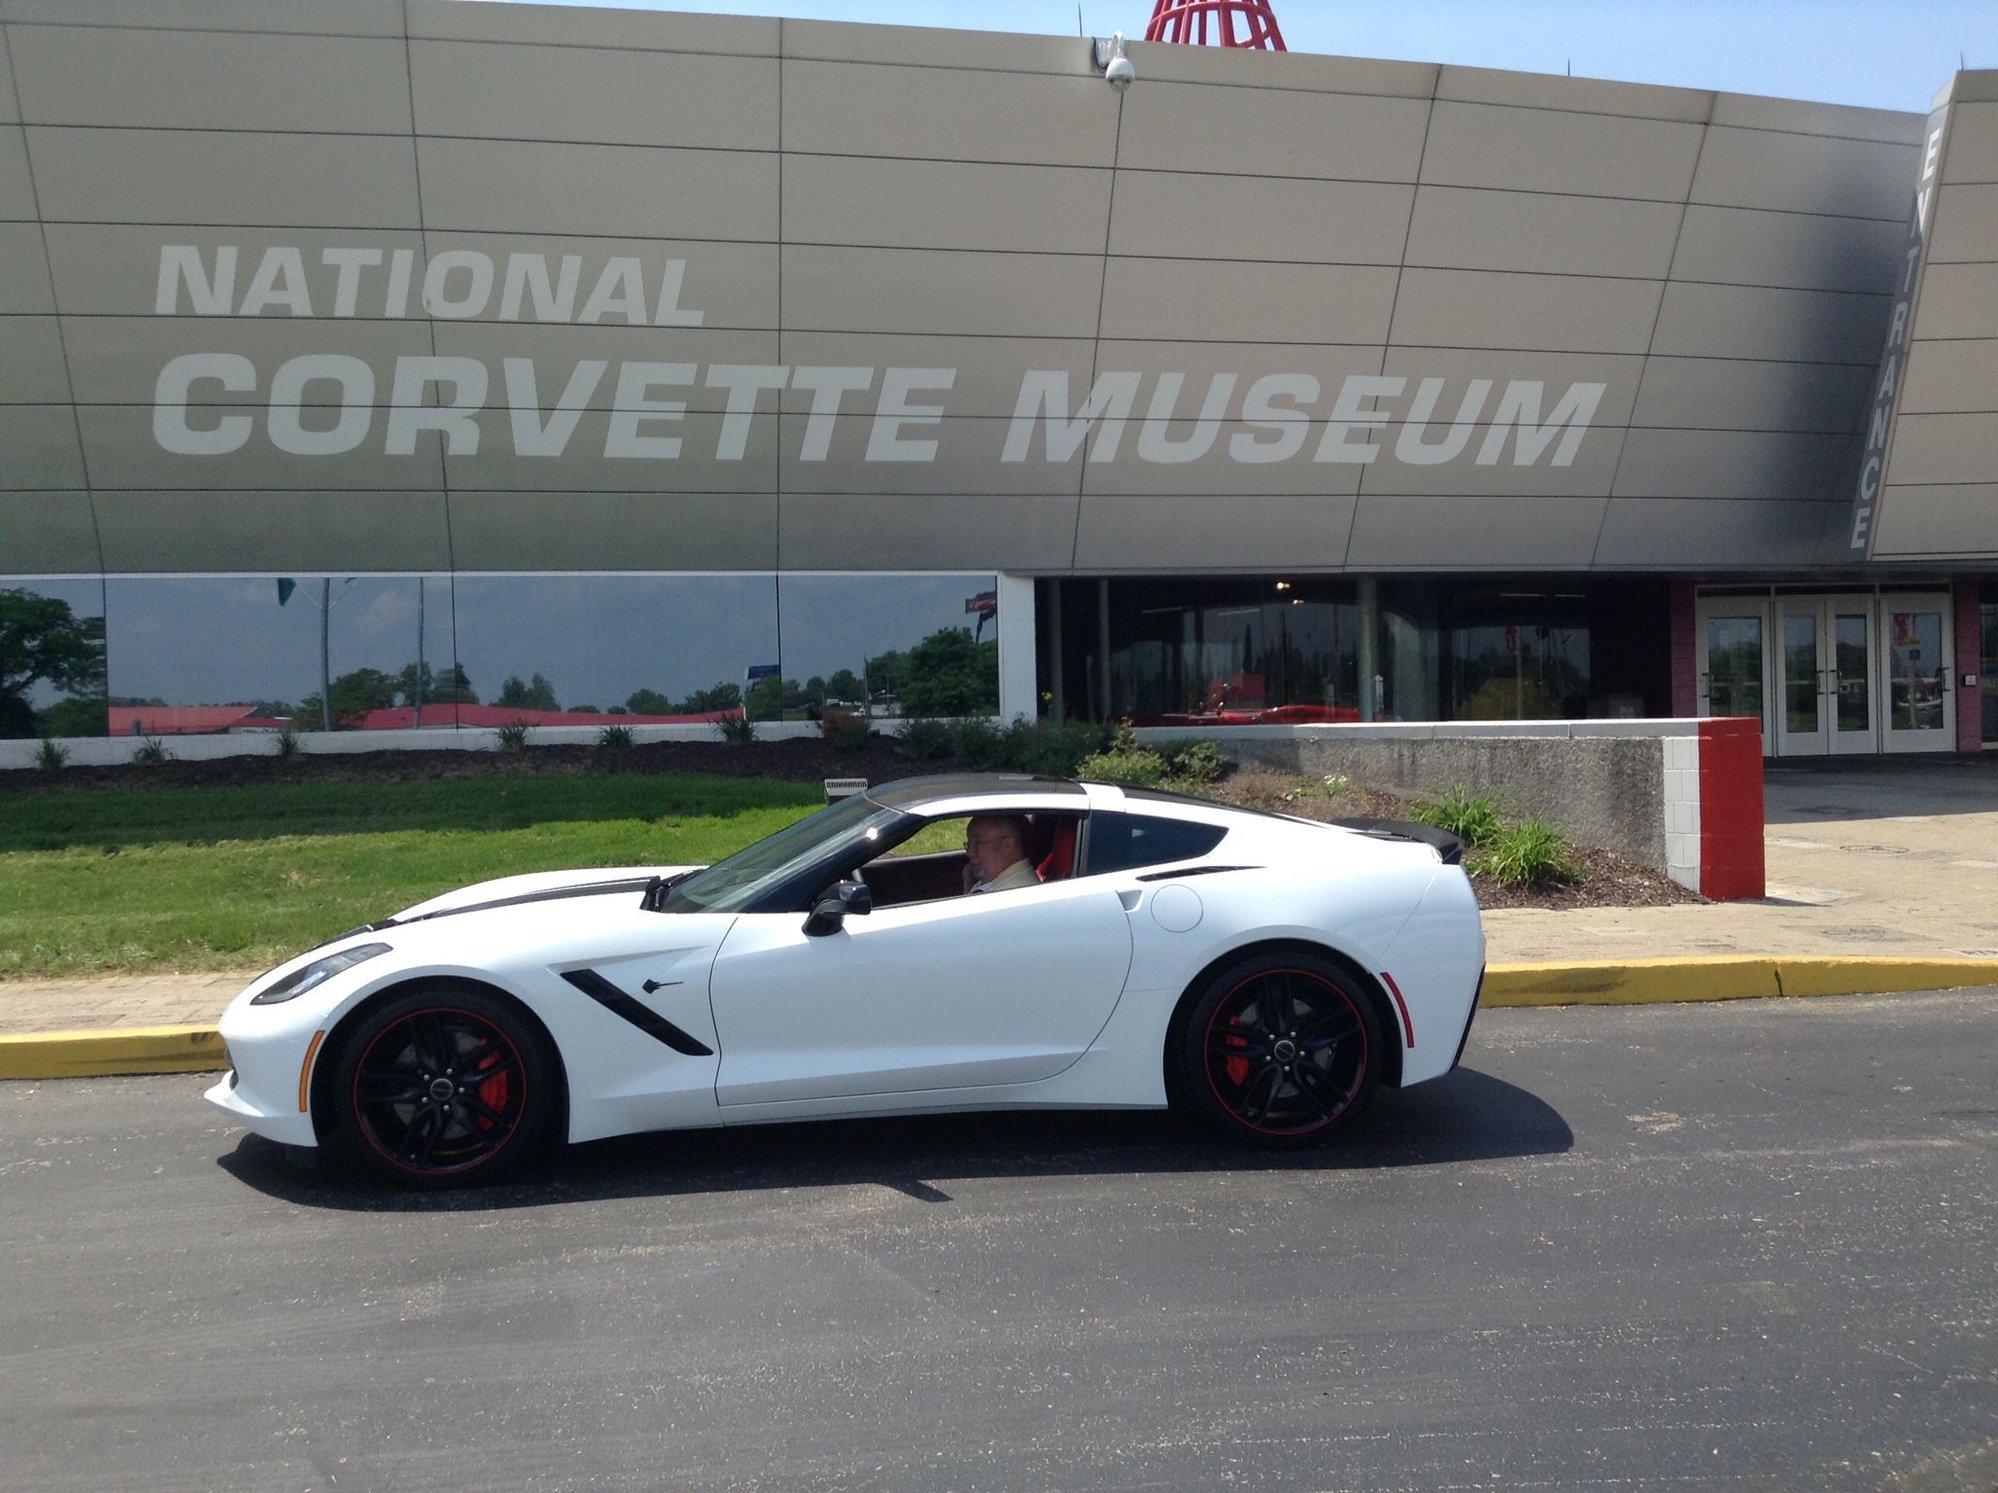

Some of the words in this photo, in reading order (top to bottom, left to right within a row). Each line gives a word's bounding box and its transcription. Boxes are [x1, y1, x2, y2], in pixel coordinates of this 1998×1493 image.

[154, 245, 704, 326] NATIONAL
[1850, 128, 1940, 548] ENTRANCE
[152, 352, 956, 461] CORVETTE
[1002, 369, 1607, 467] MUSEUM
